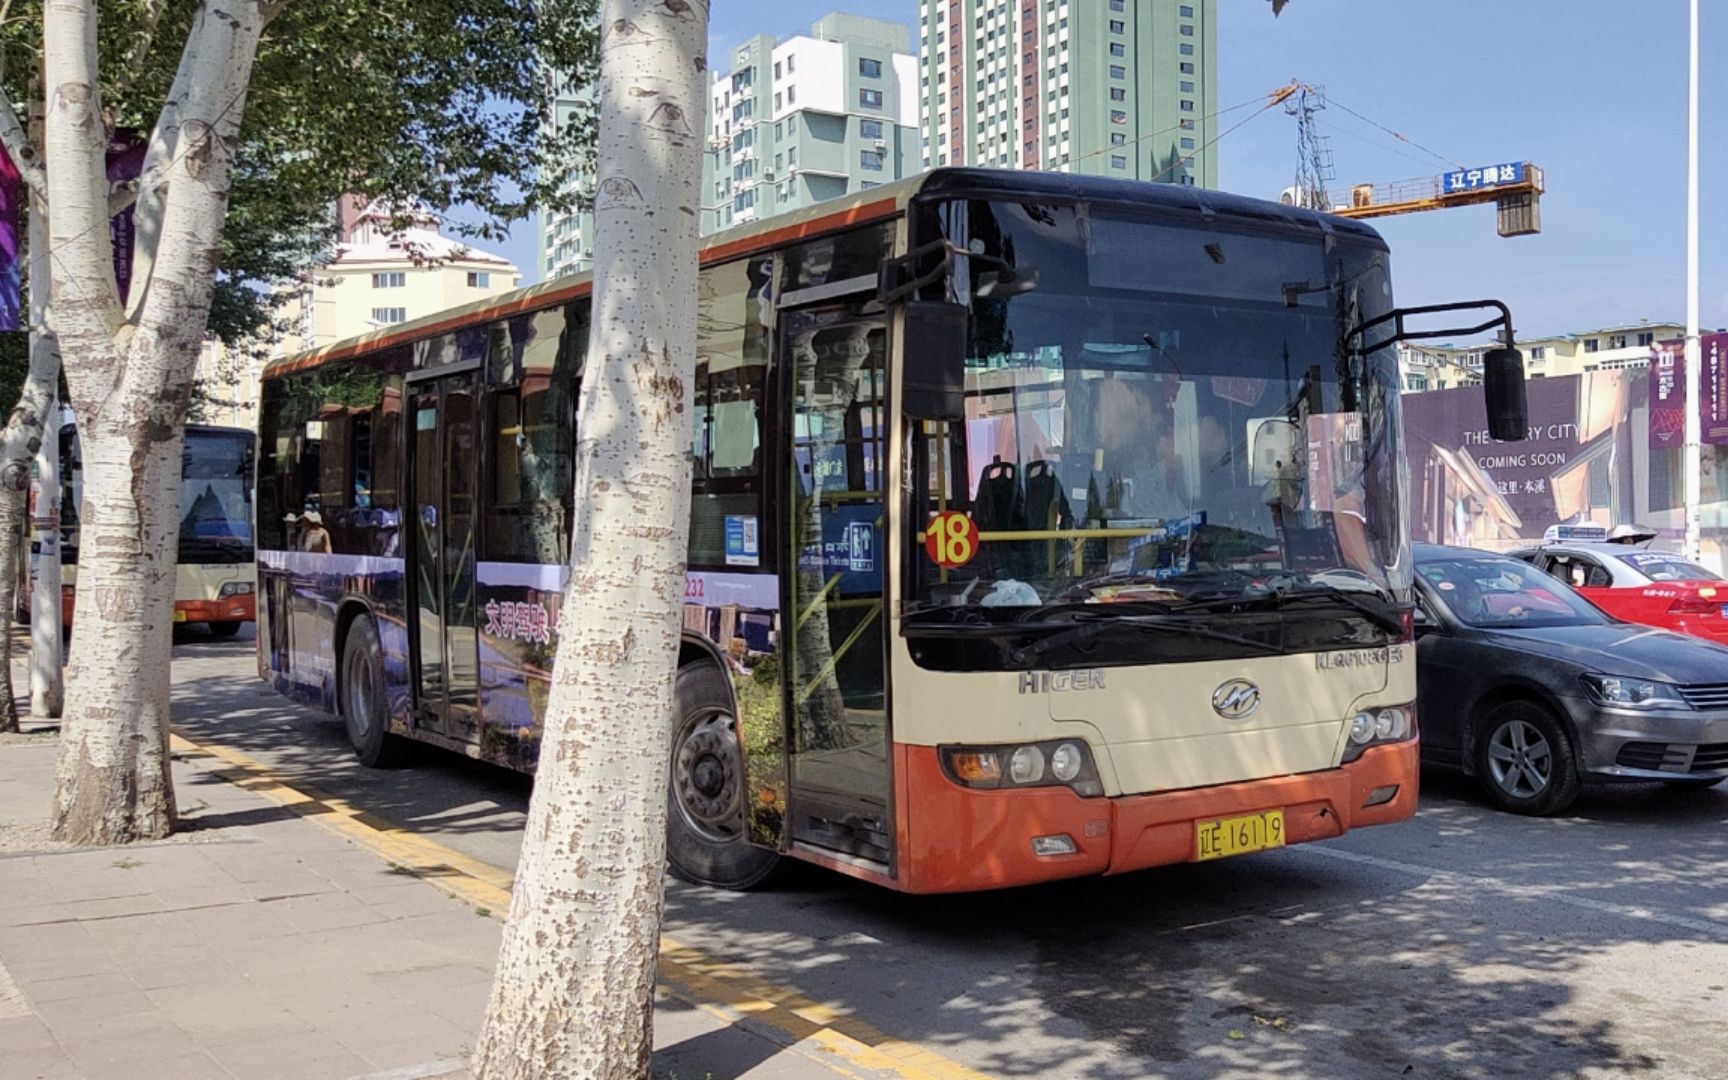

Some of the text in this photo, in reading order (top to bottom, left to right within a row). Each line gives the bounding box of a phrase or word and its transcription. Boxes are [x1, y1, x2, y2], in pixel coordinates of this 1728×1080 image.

[1464, 430, 1489, 445] THE
[1547, 423, 1581, 440] CITY
[1479, 453, 1566, 469] COMING SOON
[927, 513, 972, 564] 18
[485, 598, 549, 646] 文明驾驶
[1018, 669, 1106, 695] HIGER
